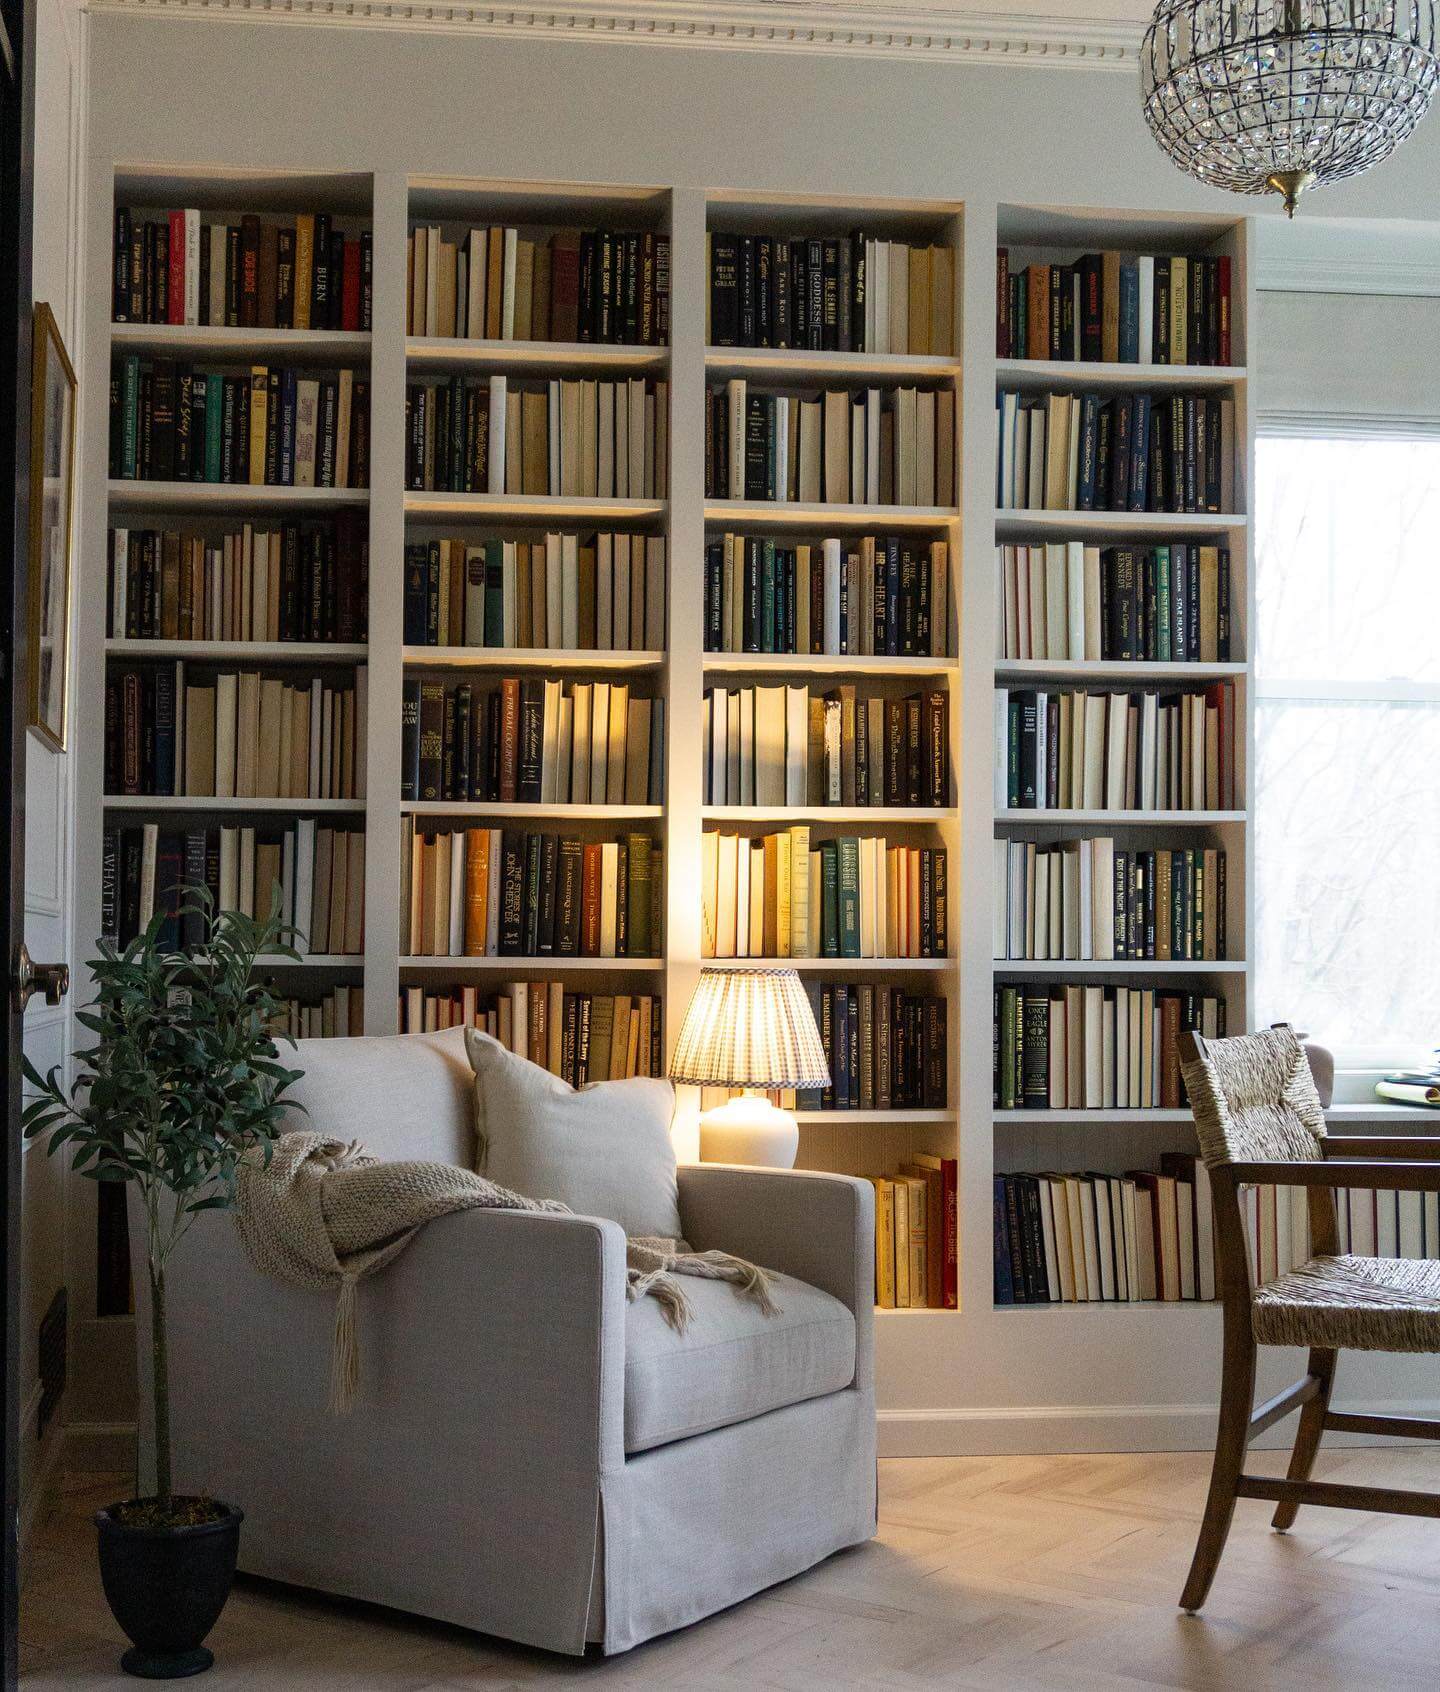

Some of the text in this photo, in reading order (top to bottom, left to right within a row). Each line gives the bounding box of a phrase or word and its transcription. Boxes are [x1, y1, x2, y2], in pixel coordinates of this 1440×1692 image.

[629, 240, 637, 254] The
[656, 242, 669, 269] FOSTER
[316, 266, 327, 302] BURN
[602, 271, 610, 295] SEASON
[628, 277, 637, 305] Religion
[656, 271, 669, 293] CHILD
[812, 273, 822, 323] GODDESS
[777, 299, 786, 325] ROAD
[1175, 286, 1184, 352] COMMUNICATION
[902, 552, 910, 584] HEARING
[1117, 552, 1125, 590] KENNEDY
[1125, 552, 1133, 580] EDWARD
[875, 551, 886, 620] HR HEART
[530, 708, 541, 760] John Adams
[932, 726, 941, 752] Question
[504, 732, 514, 774] GOURMET
[103, 853, 115, 899] WHAT
[842, 842, 857, 892] LONGSHOT
[504, 851, 515, 923] JOHN CHEEVER
[512, 866, 522, 924] THE STORIES OF
[1116, 891, 1125, 911] NIGHT
[103, 903, 114, 916] IF
[582, 1000, 591, 1024] Survival
[823, 993, 831, 1036] REMEMBER
[929, 1005, 937, 1050] HISTORIAN
[863, 1023, 872, 1051] CHARLES
[880, 1023, 889, 1047] Kings
[880, 1057, 888, 1092] Creation
